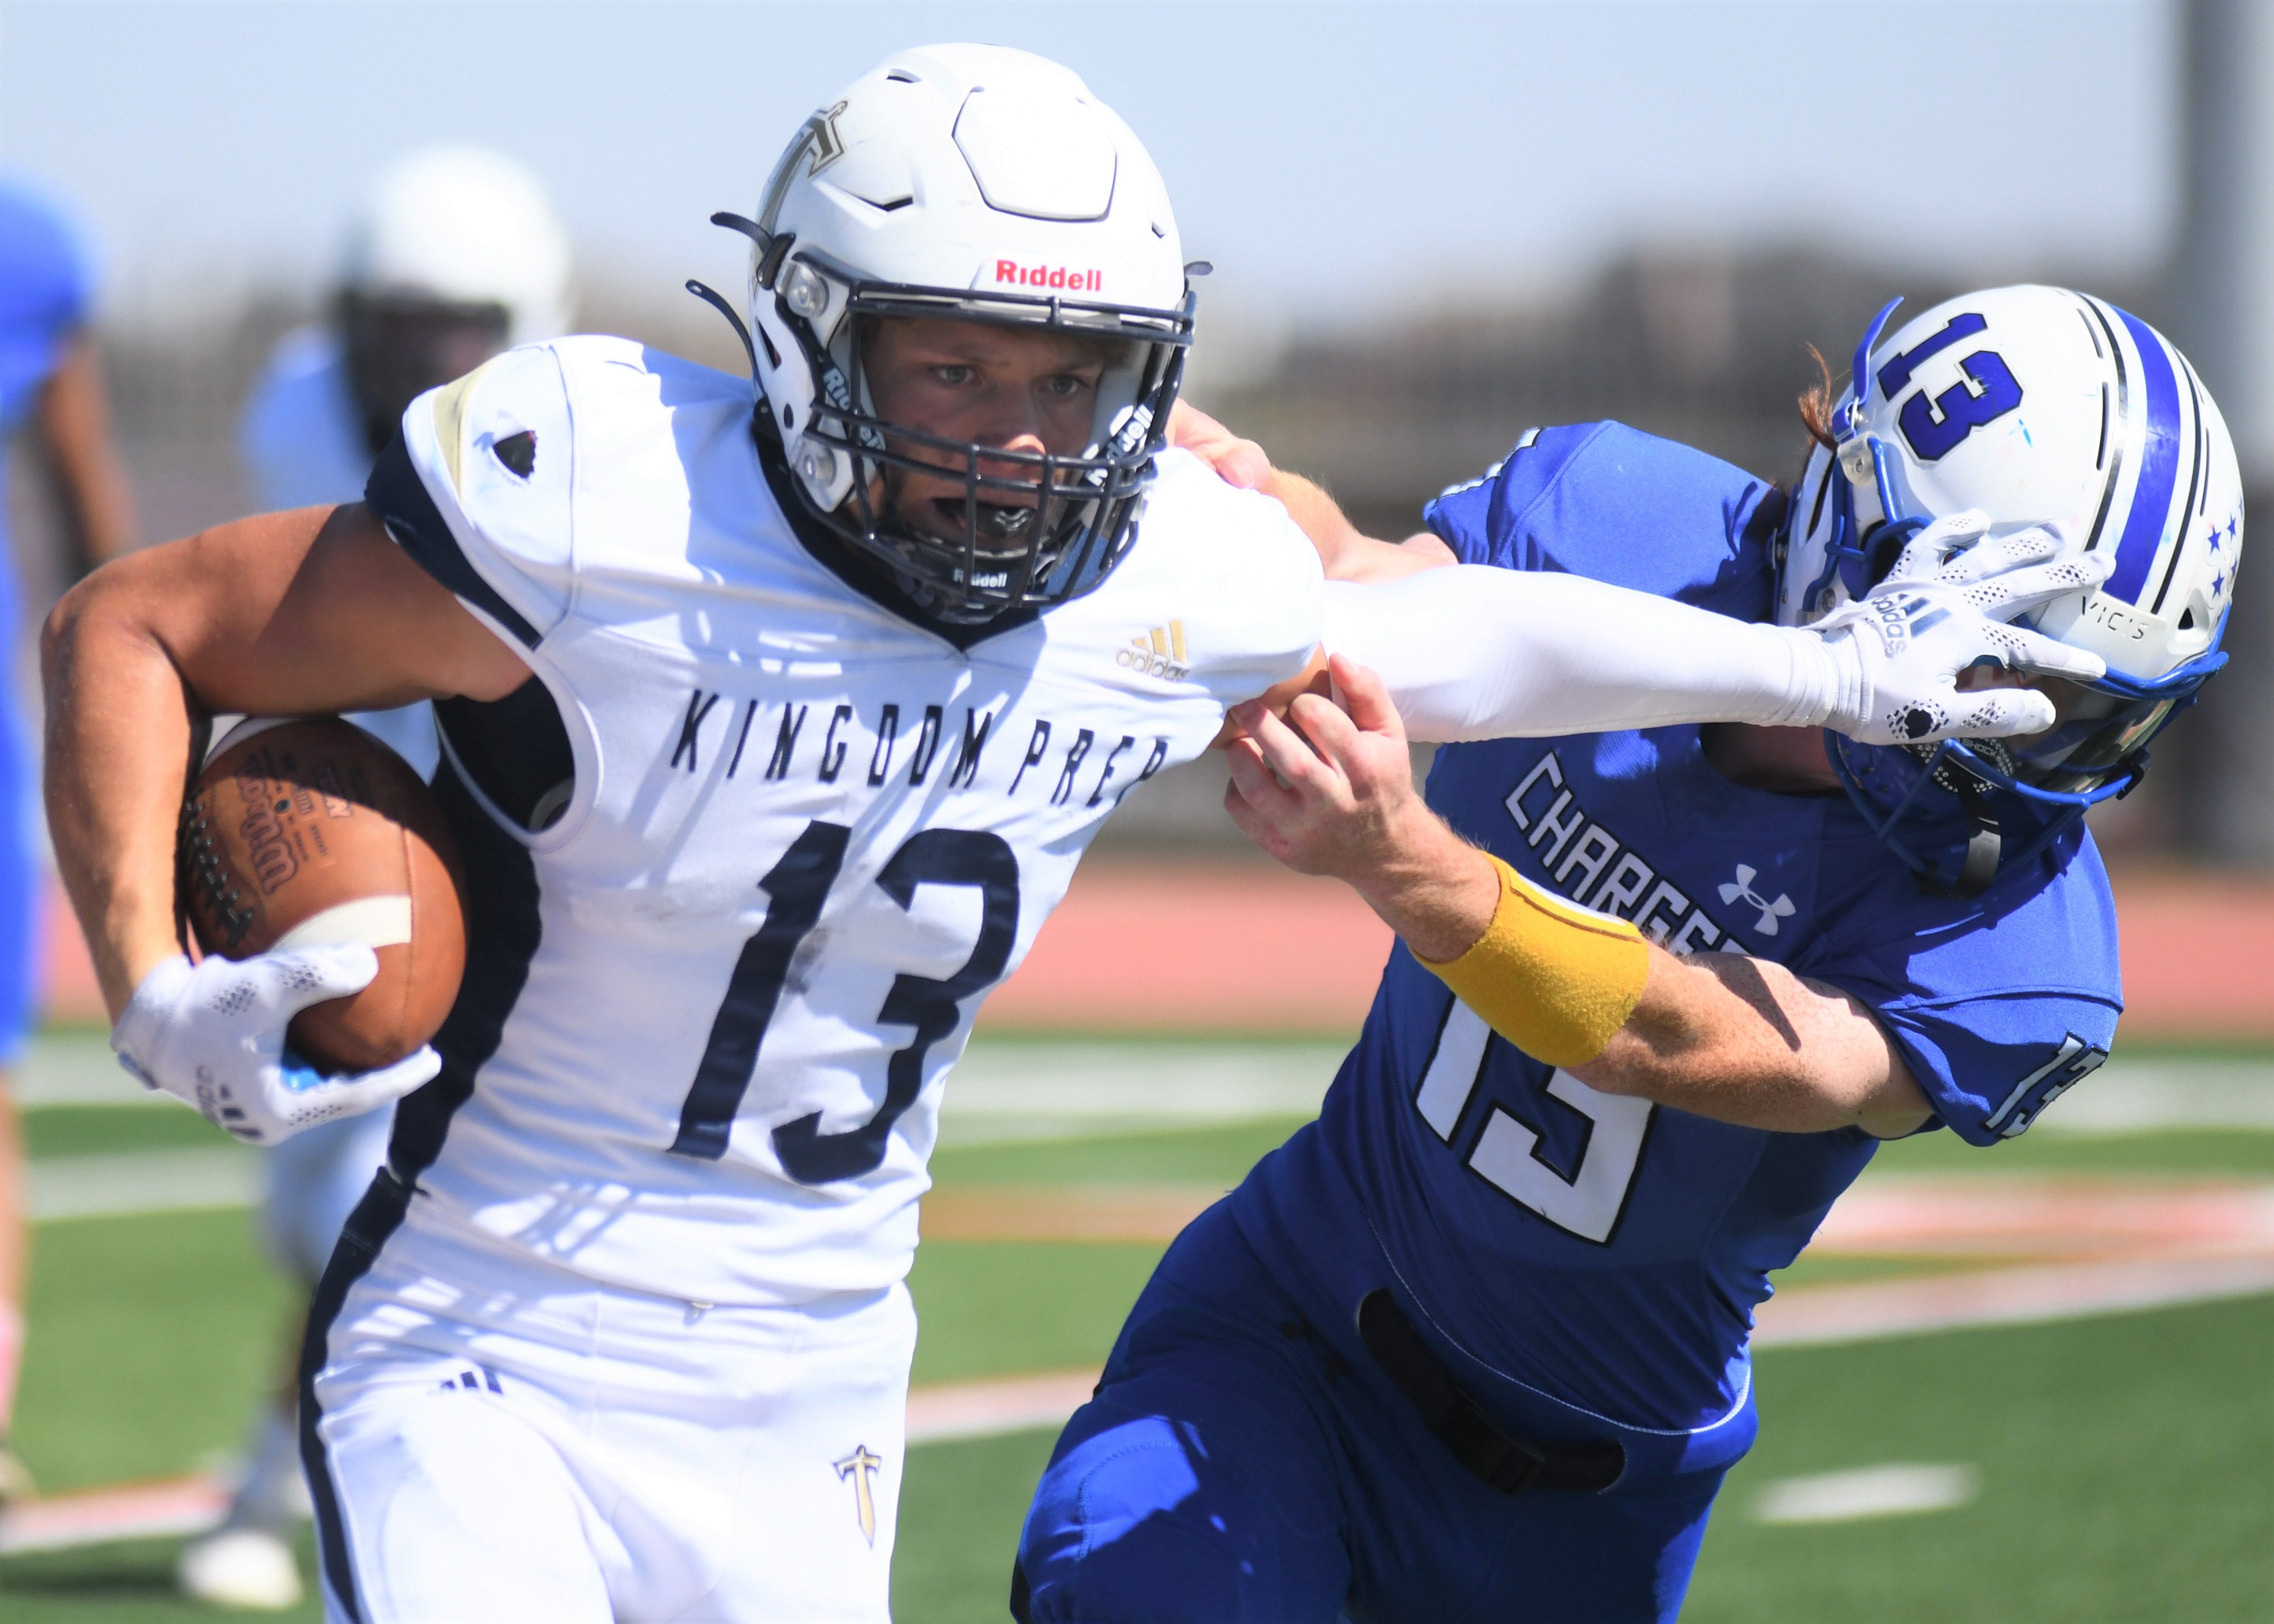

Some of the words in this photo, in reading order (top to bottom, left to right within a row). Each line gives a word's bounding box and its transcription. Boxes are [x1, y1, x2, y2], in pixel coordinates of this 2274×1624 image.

[996, 259, 1101, 292] Riddell
[823, 367, 883, 450] Riel
[1877, 312, 2024, 461] 13
[1084, 404, 1153, 486] Rddell
[953, 569, 1007, 587] Rddell
[1116, 649, 1190, 681] adidas
[671, 689, 992, 788] KINGDOM
[1007, 719, 1168, 808] PREP
[1961, 738, 1998, 757] SHOCK
[1504, 749, 1755, 956] CHARGE
[666, 820, 1019, 1184] 13
[1979, 1031, 2109, 1139] 13
